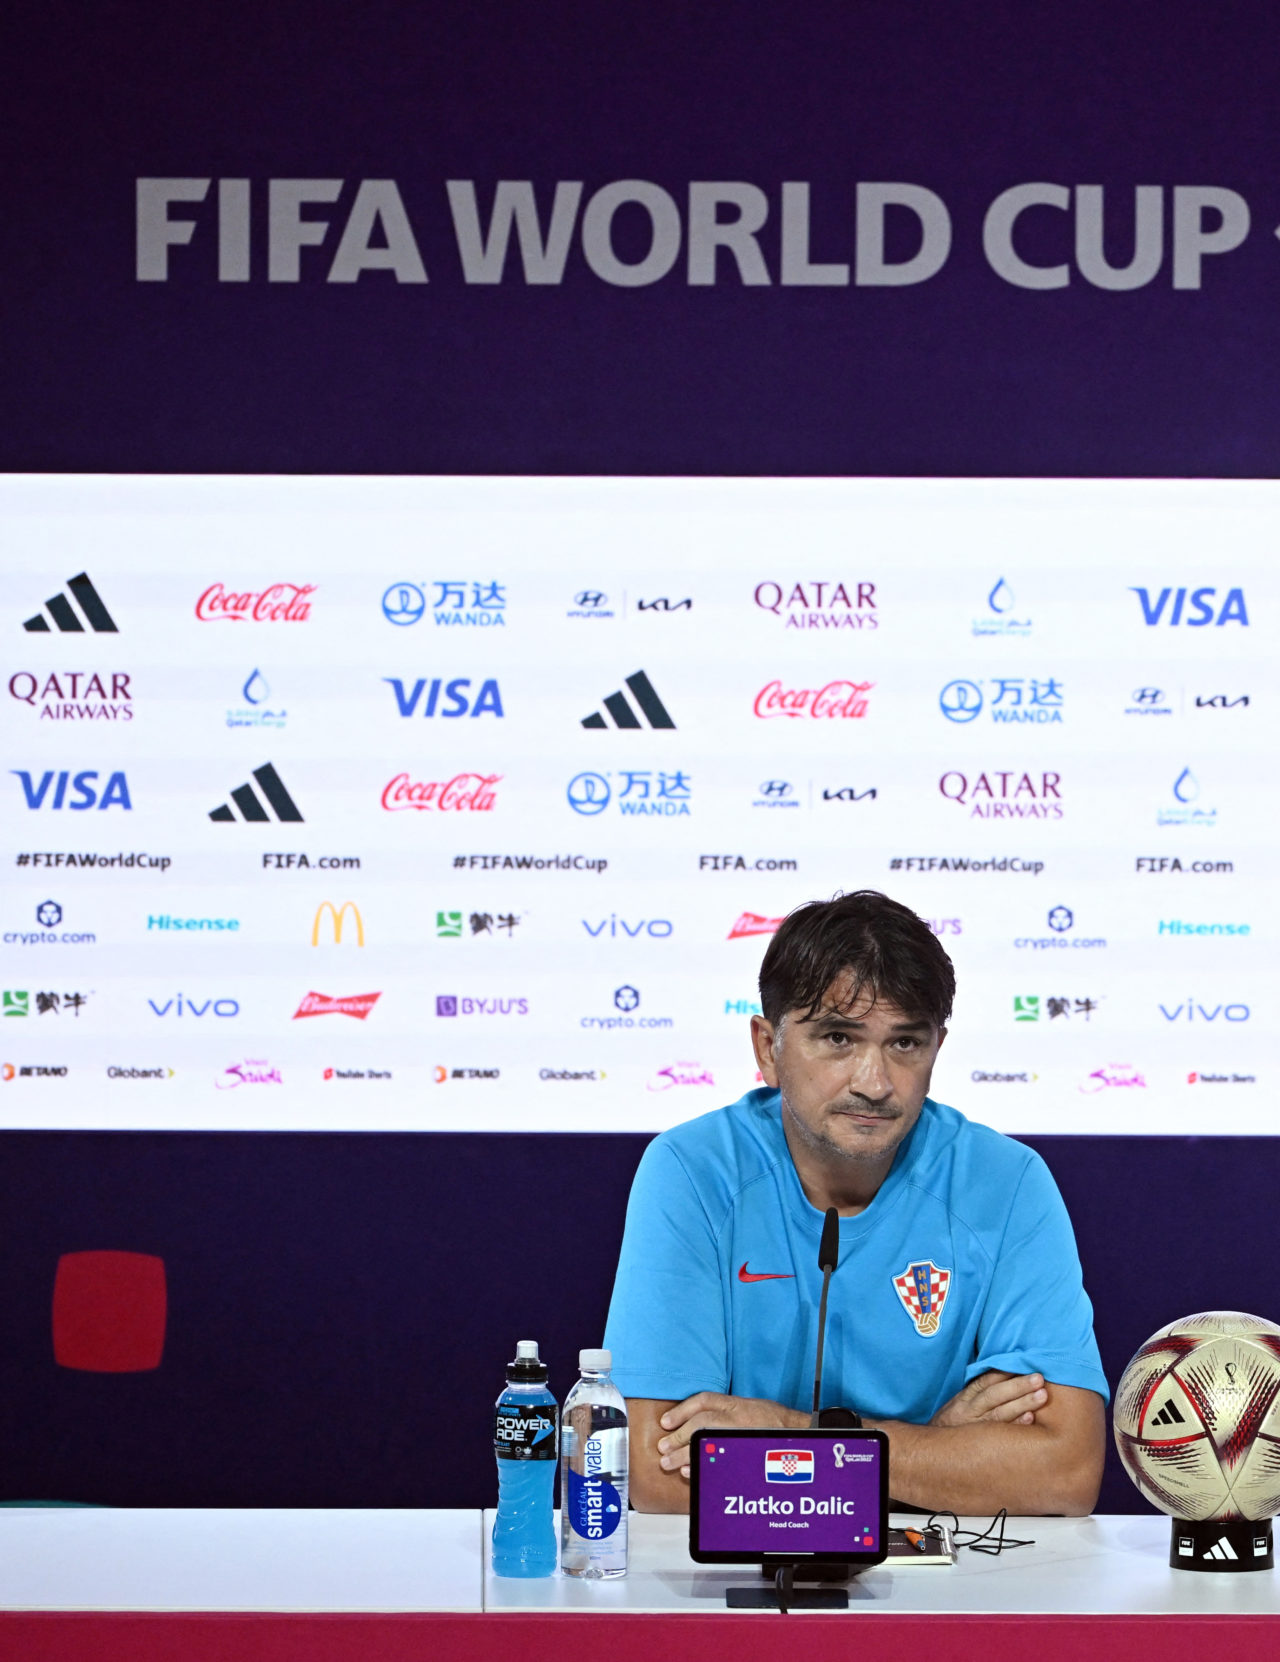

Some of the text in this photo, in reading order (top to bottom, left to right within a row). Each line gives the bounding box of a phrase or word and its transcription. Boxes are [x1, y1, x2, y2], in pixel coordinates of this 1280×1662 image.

[137, 179, 428, 283] FIFA
[447, 180, 951, 286] WORLD
[983, 183, 1250, 290] CUP
[432, 580, 506, 609] 万达
[754, 581, 877, 613] QATAR
[1128, 587, 1249, 627] VISA
[434, 611, 505, 626] WANDA
[787, 613, 878, 629] AIRWAYS
[8, 672, 132, 703] QATAR
[990, 677, 1063, 706] 万达
[382, 678, 504, 718] VISA
[40, 704, 133, 720] AIRWAYS
[992, 709, 1063, 723] WANDA
[10, 770, 132, 811] VISA
[618, 770, 691, 799] 万达
[939, 771, 1061, 803] QATAR
[619, 801, 690, 816] WANDA
[972, 803, 1063, 818] AIRWAYS
[16, 852, 171, 872] #FIFAWorldCup
[262, 853, 360, 869] FIFA.com
[453, 855, 608, 874] #FIFAWorldCup
[699, 855, 797, 871] FIFA.com
[890, 857, 1044, 875] #FIFAWorldCup
[1136, 857, 1233, 873] FIFA.com
[147, 915, 240, 931] Hisense
[469, 912, 520, 937] 蒙牛
[582, 915, 673, 937] vivo
[931, 918, 962, 935] U'S
[1158, 920, 1251, 935] Hisense
[3, 932, 96, 945] crypto.com
[1015, 938, 1107, 950] crypto.com
[35, 991, 87, 1017] 蒙牛
[148, 993, 240, 1017] vivo
[462, 998, 528, 1015] BYJU'S
[1046, 996, 1096, 1021] 蒙牛
[1160, 999, 1250, 1021] vivo
[581, 1017, 673, 1028] crypto.com
[496, 1416, 551, 1430] POWER
[496, 1428, 525, 1441] ADE
[724, 1496, 854, 1515] Zlatko Dalic
